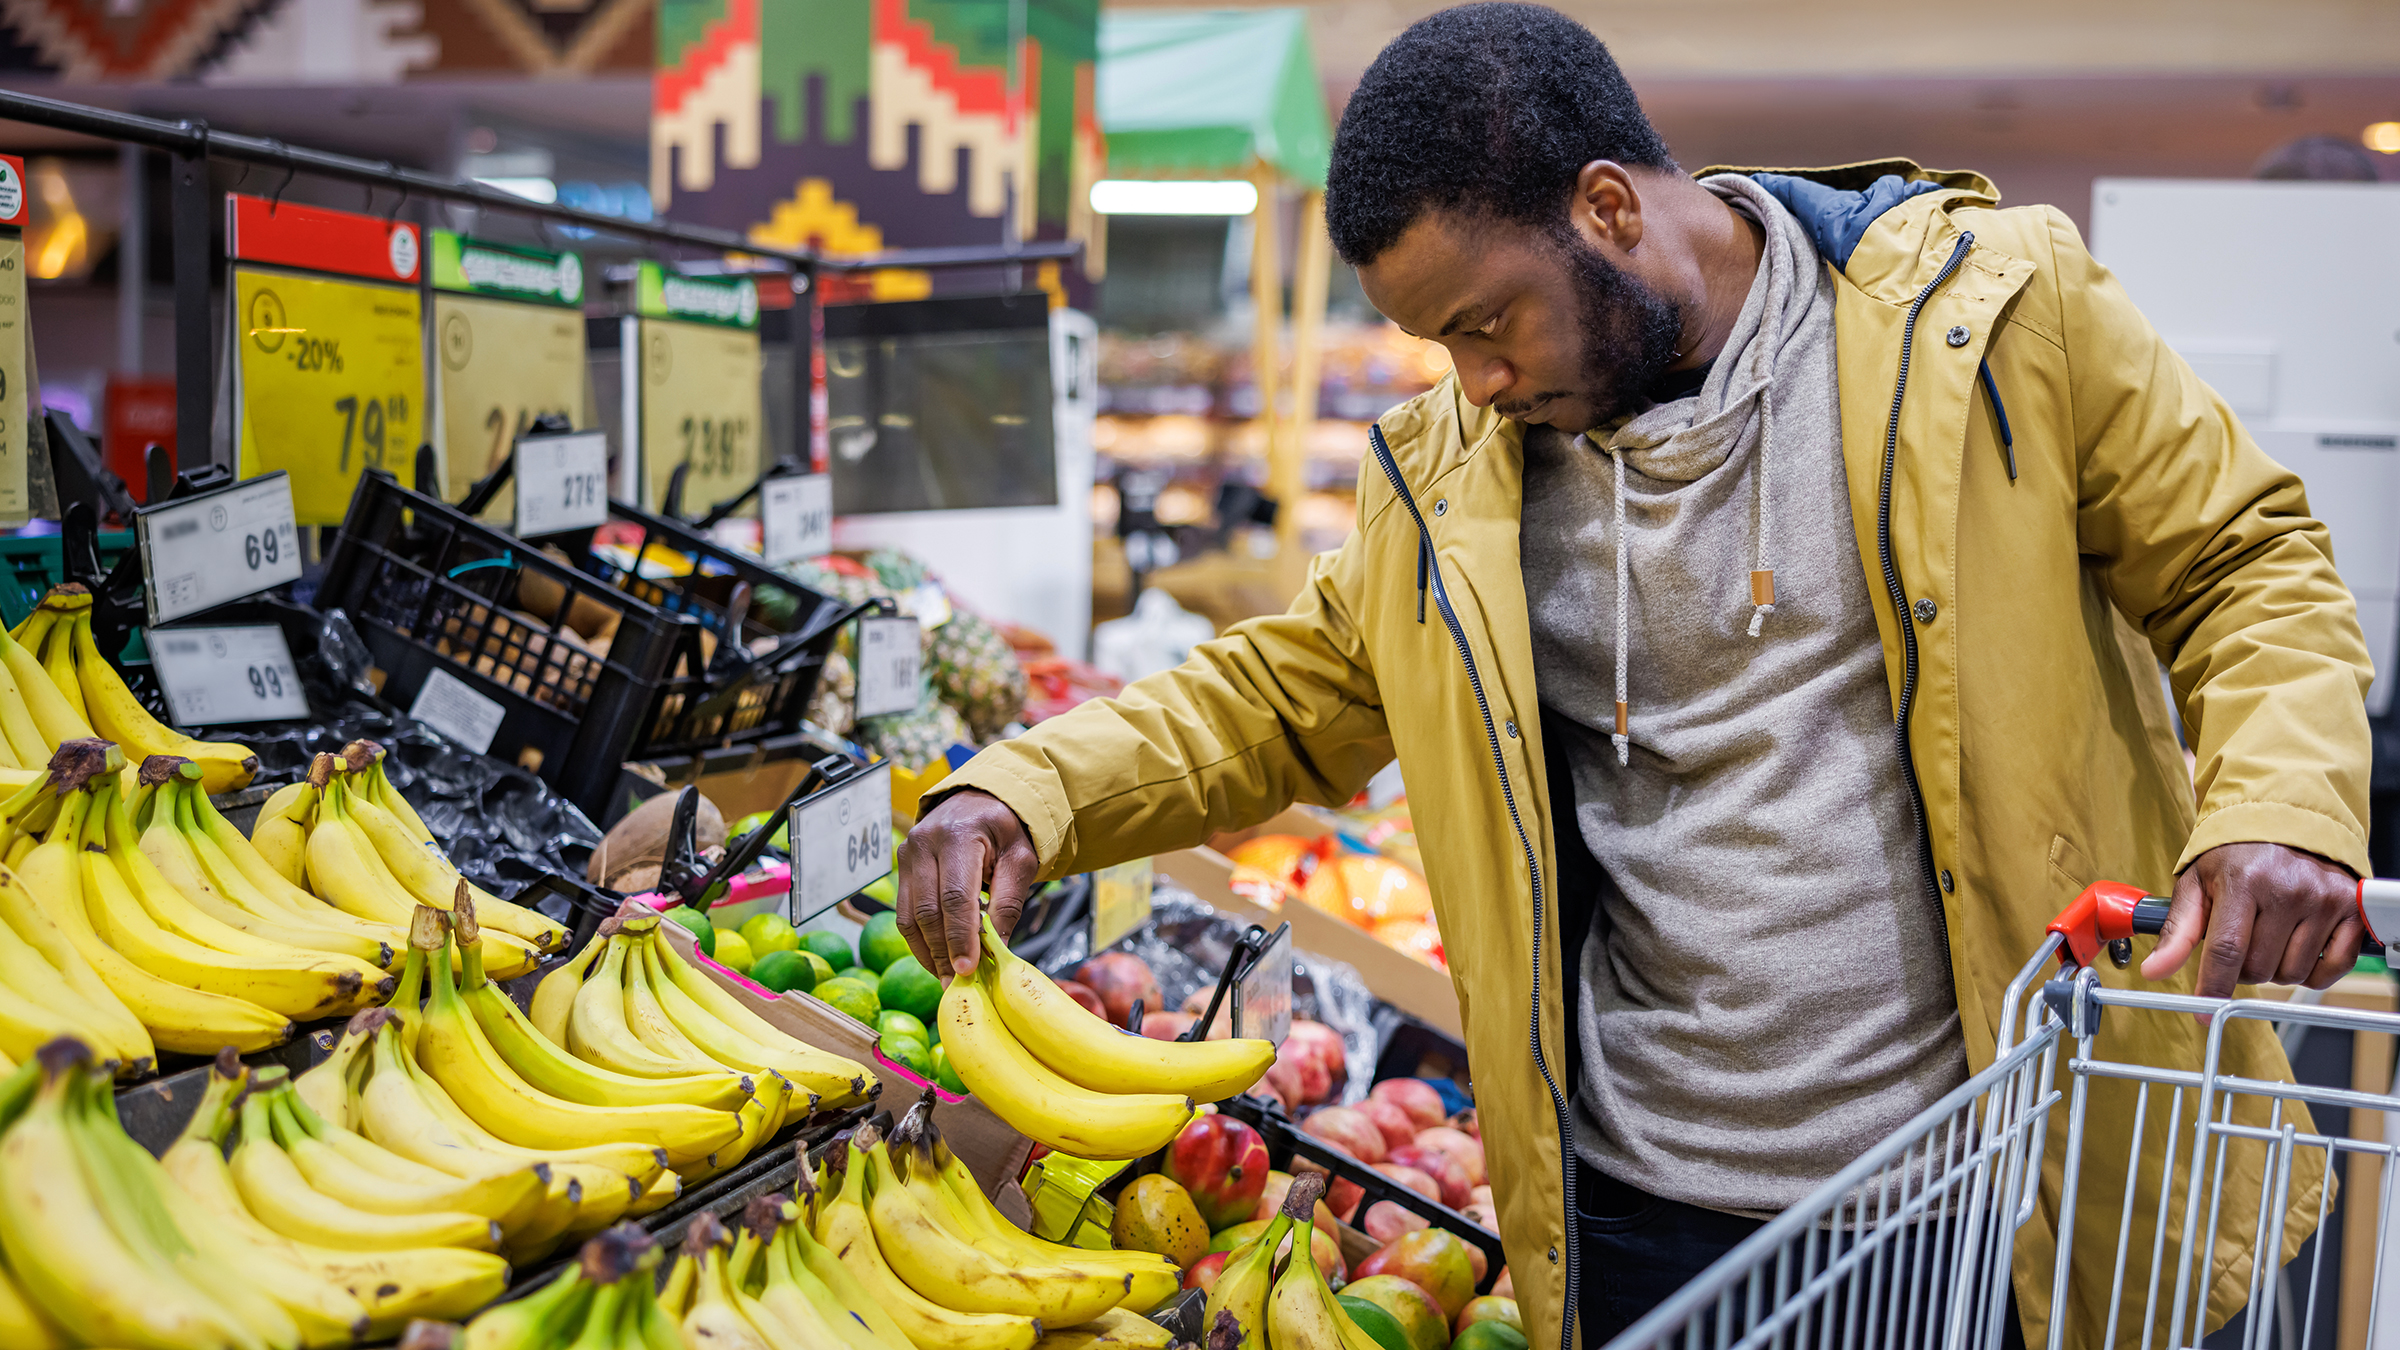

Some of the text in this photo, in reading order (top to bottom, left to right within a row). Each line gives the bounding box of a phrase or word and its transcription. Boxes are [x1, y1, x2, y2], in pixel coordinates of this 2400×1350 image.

[287, 337, 344, 374] -20%
[335, 395, 386, 474] 79
[245, 528, 279, 571] 69
[248, 664, 283, 700] 99
[847, 821, 880, 873] 649
